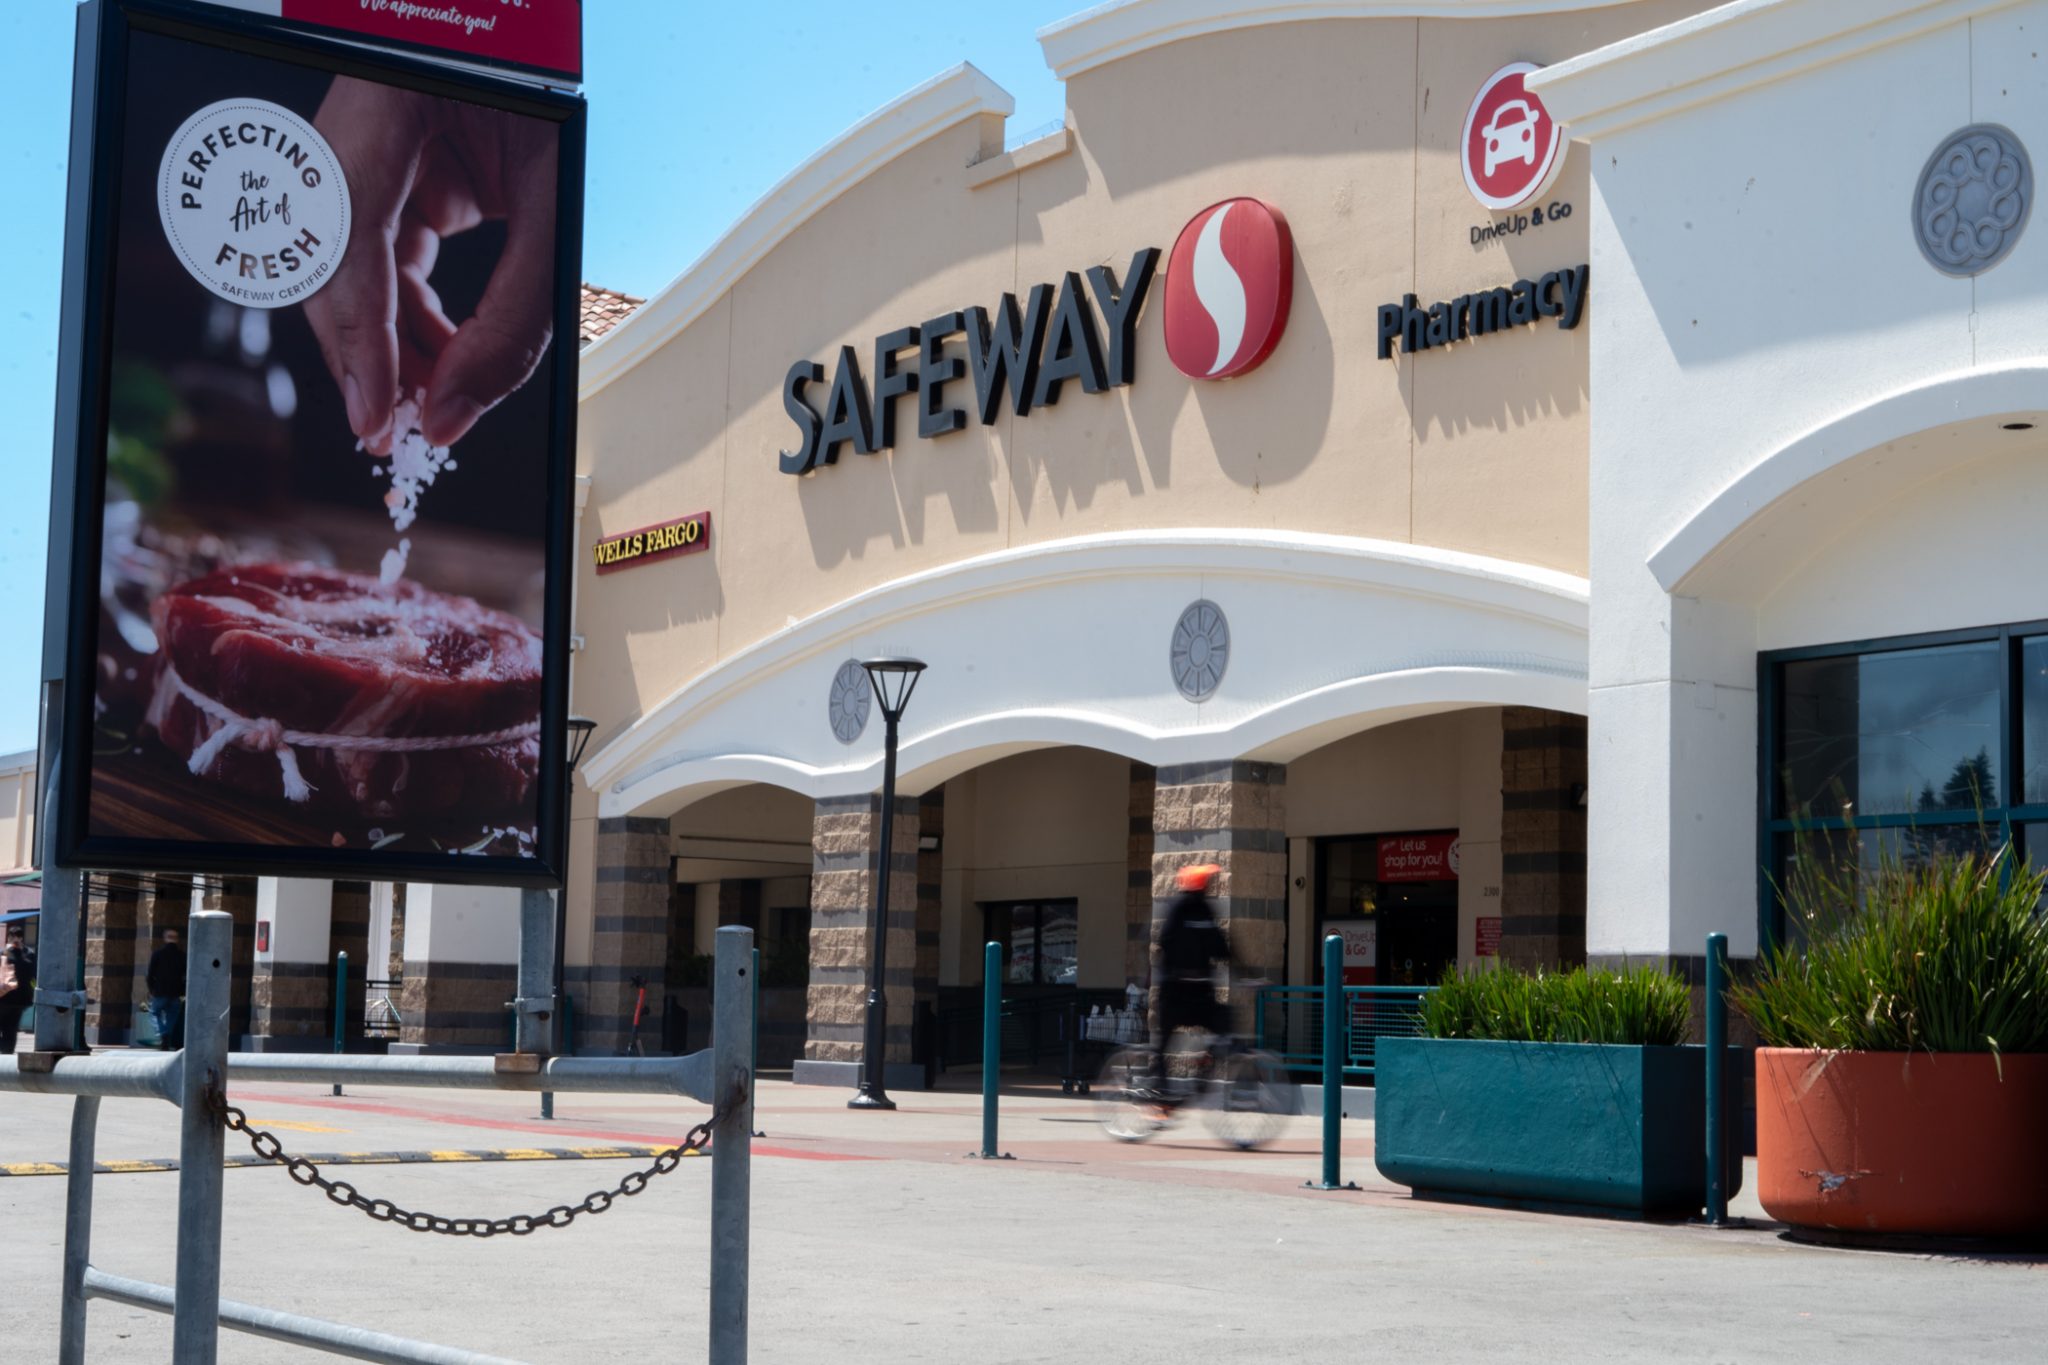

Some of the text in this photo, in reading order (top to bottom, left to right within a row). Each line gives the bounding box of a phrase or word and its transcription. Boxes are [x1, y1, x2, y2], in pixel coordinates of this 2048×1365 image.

[389, 1, 464, 25] appreciate
[464, 15, 497, 35] you!
[181, 122, 321, 210] PERFECTING
[240, 170, 269, 192] the
[229, 192, 292, 232] Art of
[1470, 201, 1572, 245] DriveUp & Go
[215, 227, 321, 280] FRESH
[220, 261, 329, 301] SAFEWAY CERTIFIED
[1377, 264, 1590, 360] Pharmacy
[778, 247, 1162, 475] SAFEWAY
[593, 519, 702, 565] WELLS FARGO
[1384, 854, 1407, 869] shop
[1407, 852, 1421, 866] for
[1400, 839, 1414, 852] Let
[1415, 840, 1427, 851] us
[1353, 943, 1367, 956] Go
